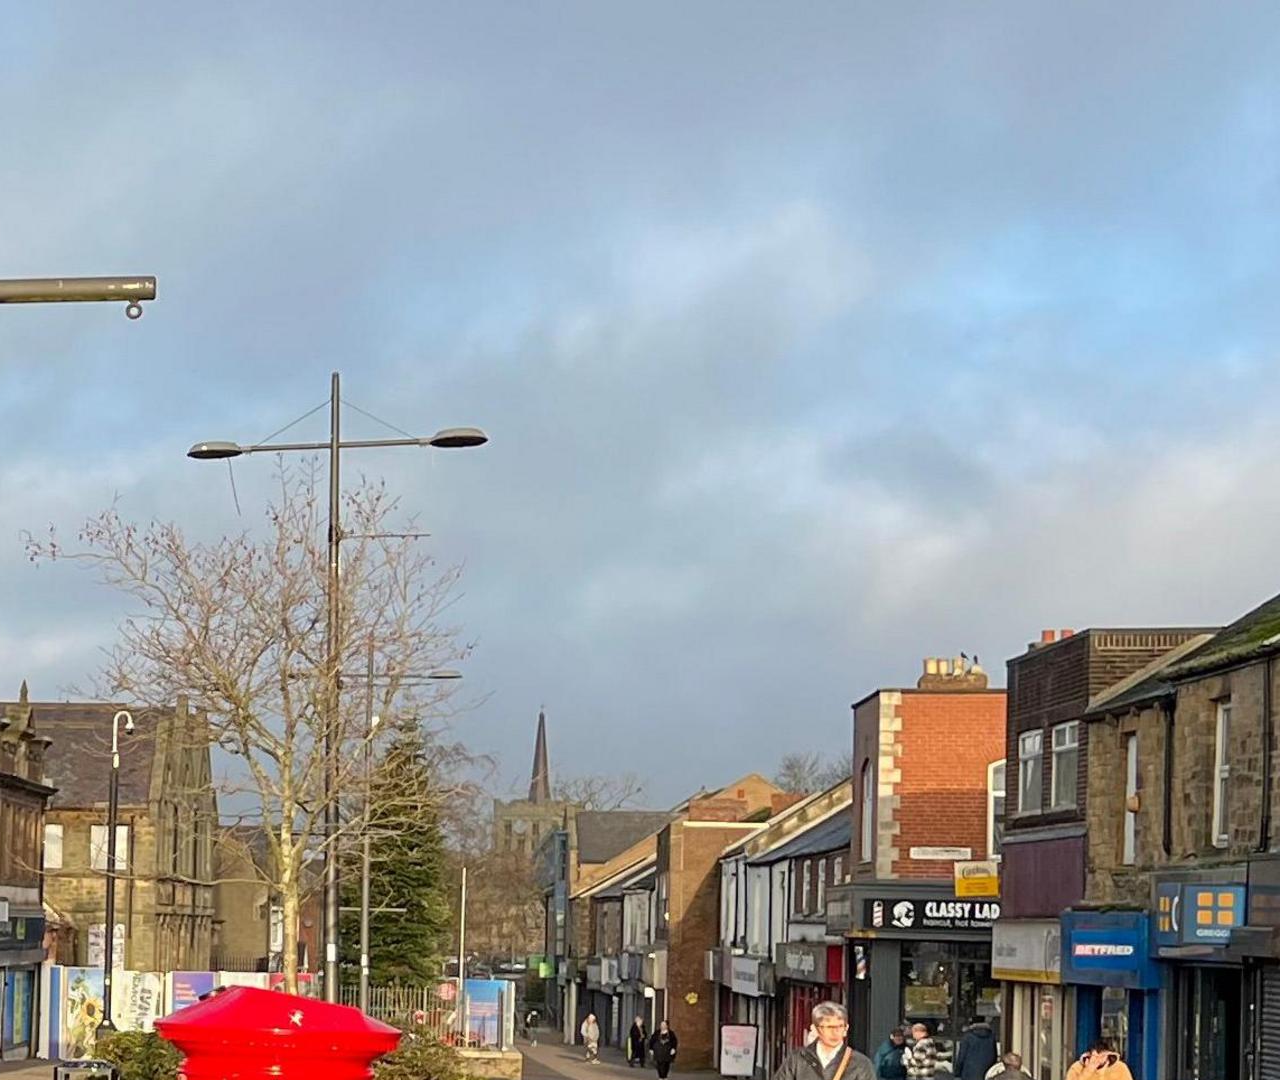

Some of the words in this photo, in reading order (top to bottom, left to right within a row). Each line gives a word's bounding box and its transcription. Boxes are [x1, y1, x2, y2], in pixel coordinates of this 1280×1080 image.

[925, 901, 971, 918] CLASSY
[975, 903, 1000, 919] LAD
[1073, 944, 1134, 956] BETFRED
